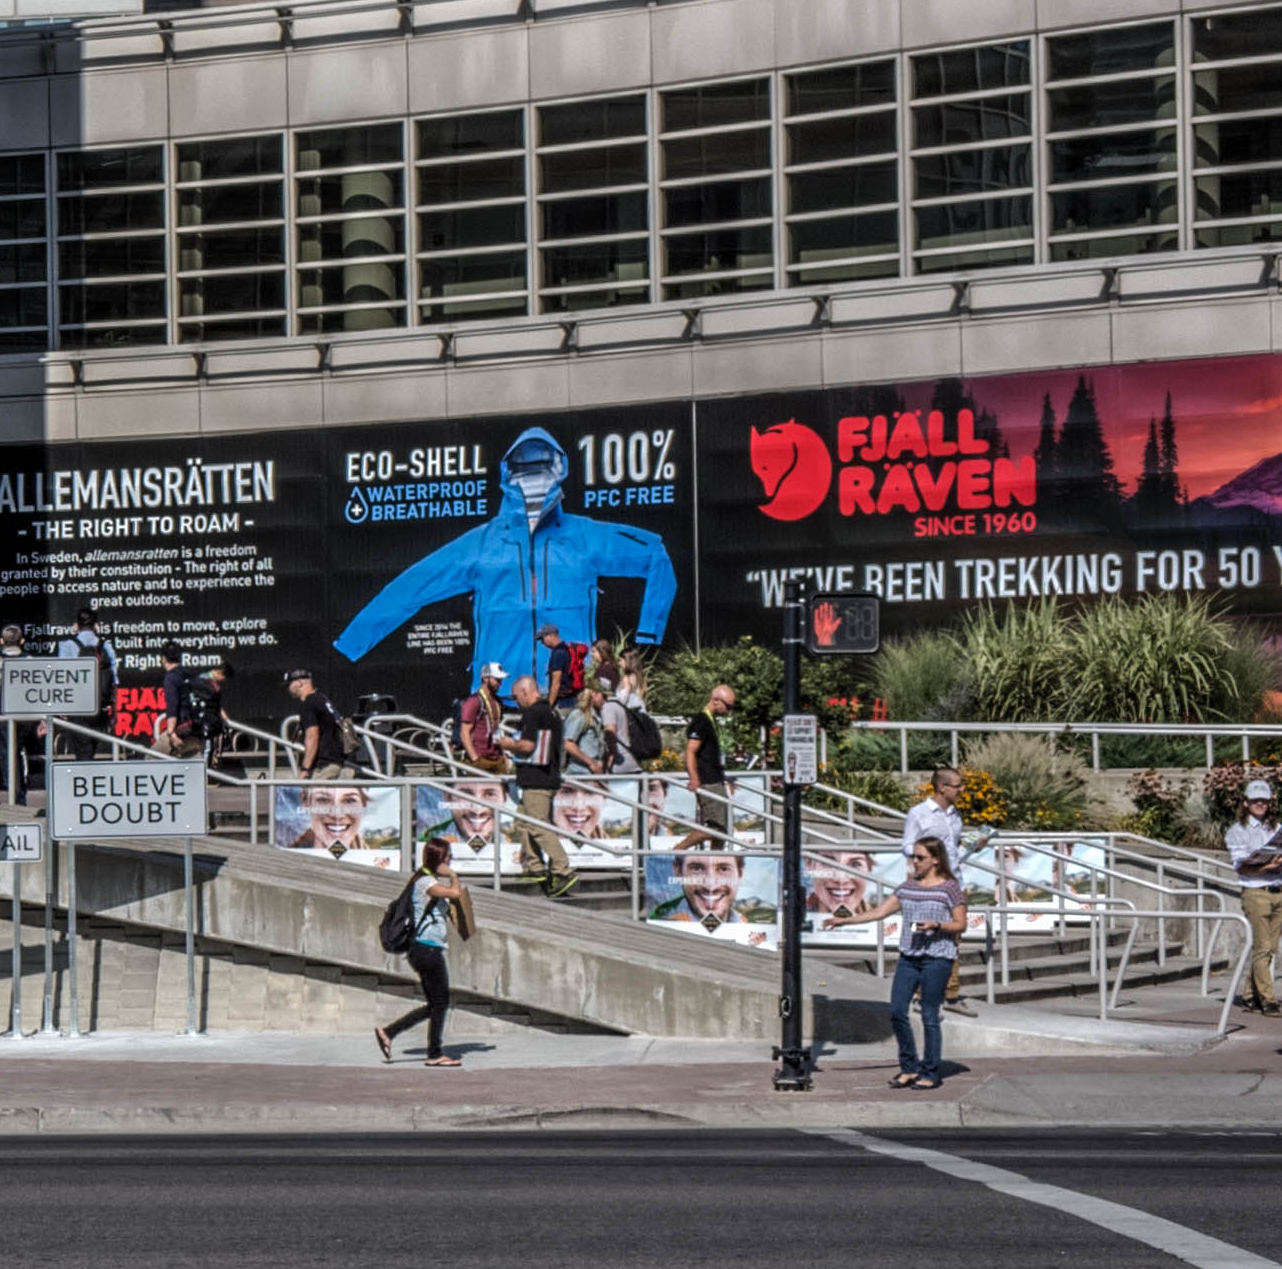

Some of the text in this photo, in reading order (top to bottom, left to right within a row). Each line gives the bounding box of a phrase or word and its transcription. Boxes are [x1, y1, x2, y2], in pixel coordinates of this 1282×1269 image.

[839, 409, 988, 462] FJÄLL
[347, 445, 486, 482] ECO-SHELL
[579, 430, 675, 484] 100%
[367, 480, 487, 502] WATERPROOF
[585, 485, 675, 508] PFC FREE
[839, 457, 1036, 517] RÄVEN
[371, 499, 487, 521] BREATHABLE
[33, 513, 239, 539] THE RIGHT TO ROAM
[914, 512, 1036, 537] SINCE 1960
[32, 552, 83, 564] Sweden,
[205, 545, 256, 557] freedom
[1, 558, 272, 581] granted their constitution The right all
[865, 561, 944, 602] BEEN
[955, 554, 1123, 598] TREKKING
[1137, 548, 1205, 591] FOR
[1219, 547, 1260, 589] 50
[0, 574, 275, 598] people access nature and experience the
[91, 594, 184, 610] great outdoors.
[113, 617, 267, 633] freedom move, explore
[126, 653, 221, 669] Right Roam
[10, 670, 91, 684] PREVENT
[25, 689, 74, 703] CURE
[73, 774, 185, 798] BELIEVE
[79, 802, 181, 825] DOUBT
